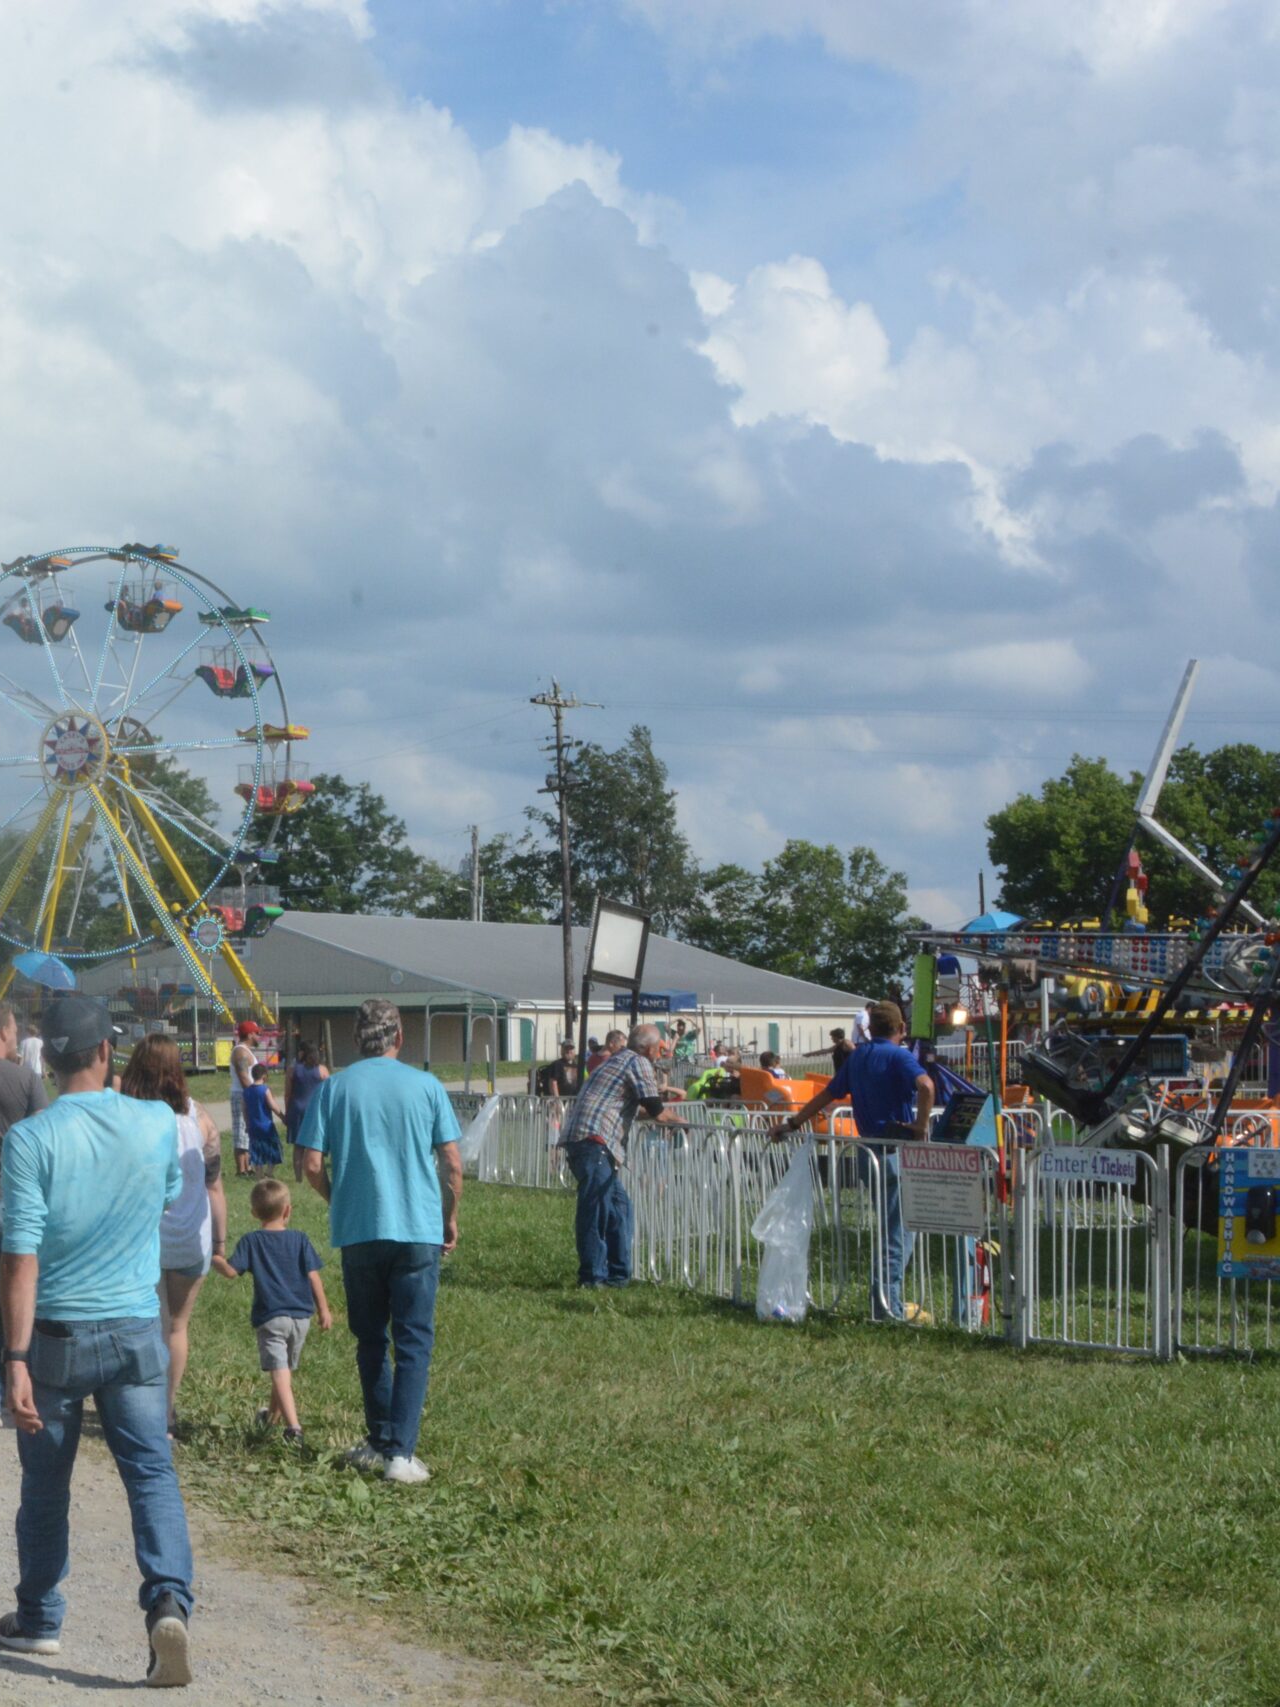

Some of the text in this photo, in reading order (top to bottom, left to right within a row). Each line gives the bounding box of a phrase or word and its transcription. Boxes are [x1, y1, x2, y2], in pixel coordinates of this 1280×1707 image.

[902, 1149, 978, 1172] WARNING
[1043, 1152, 1135, 1179] Enter 4 Tickets
